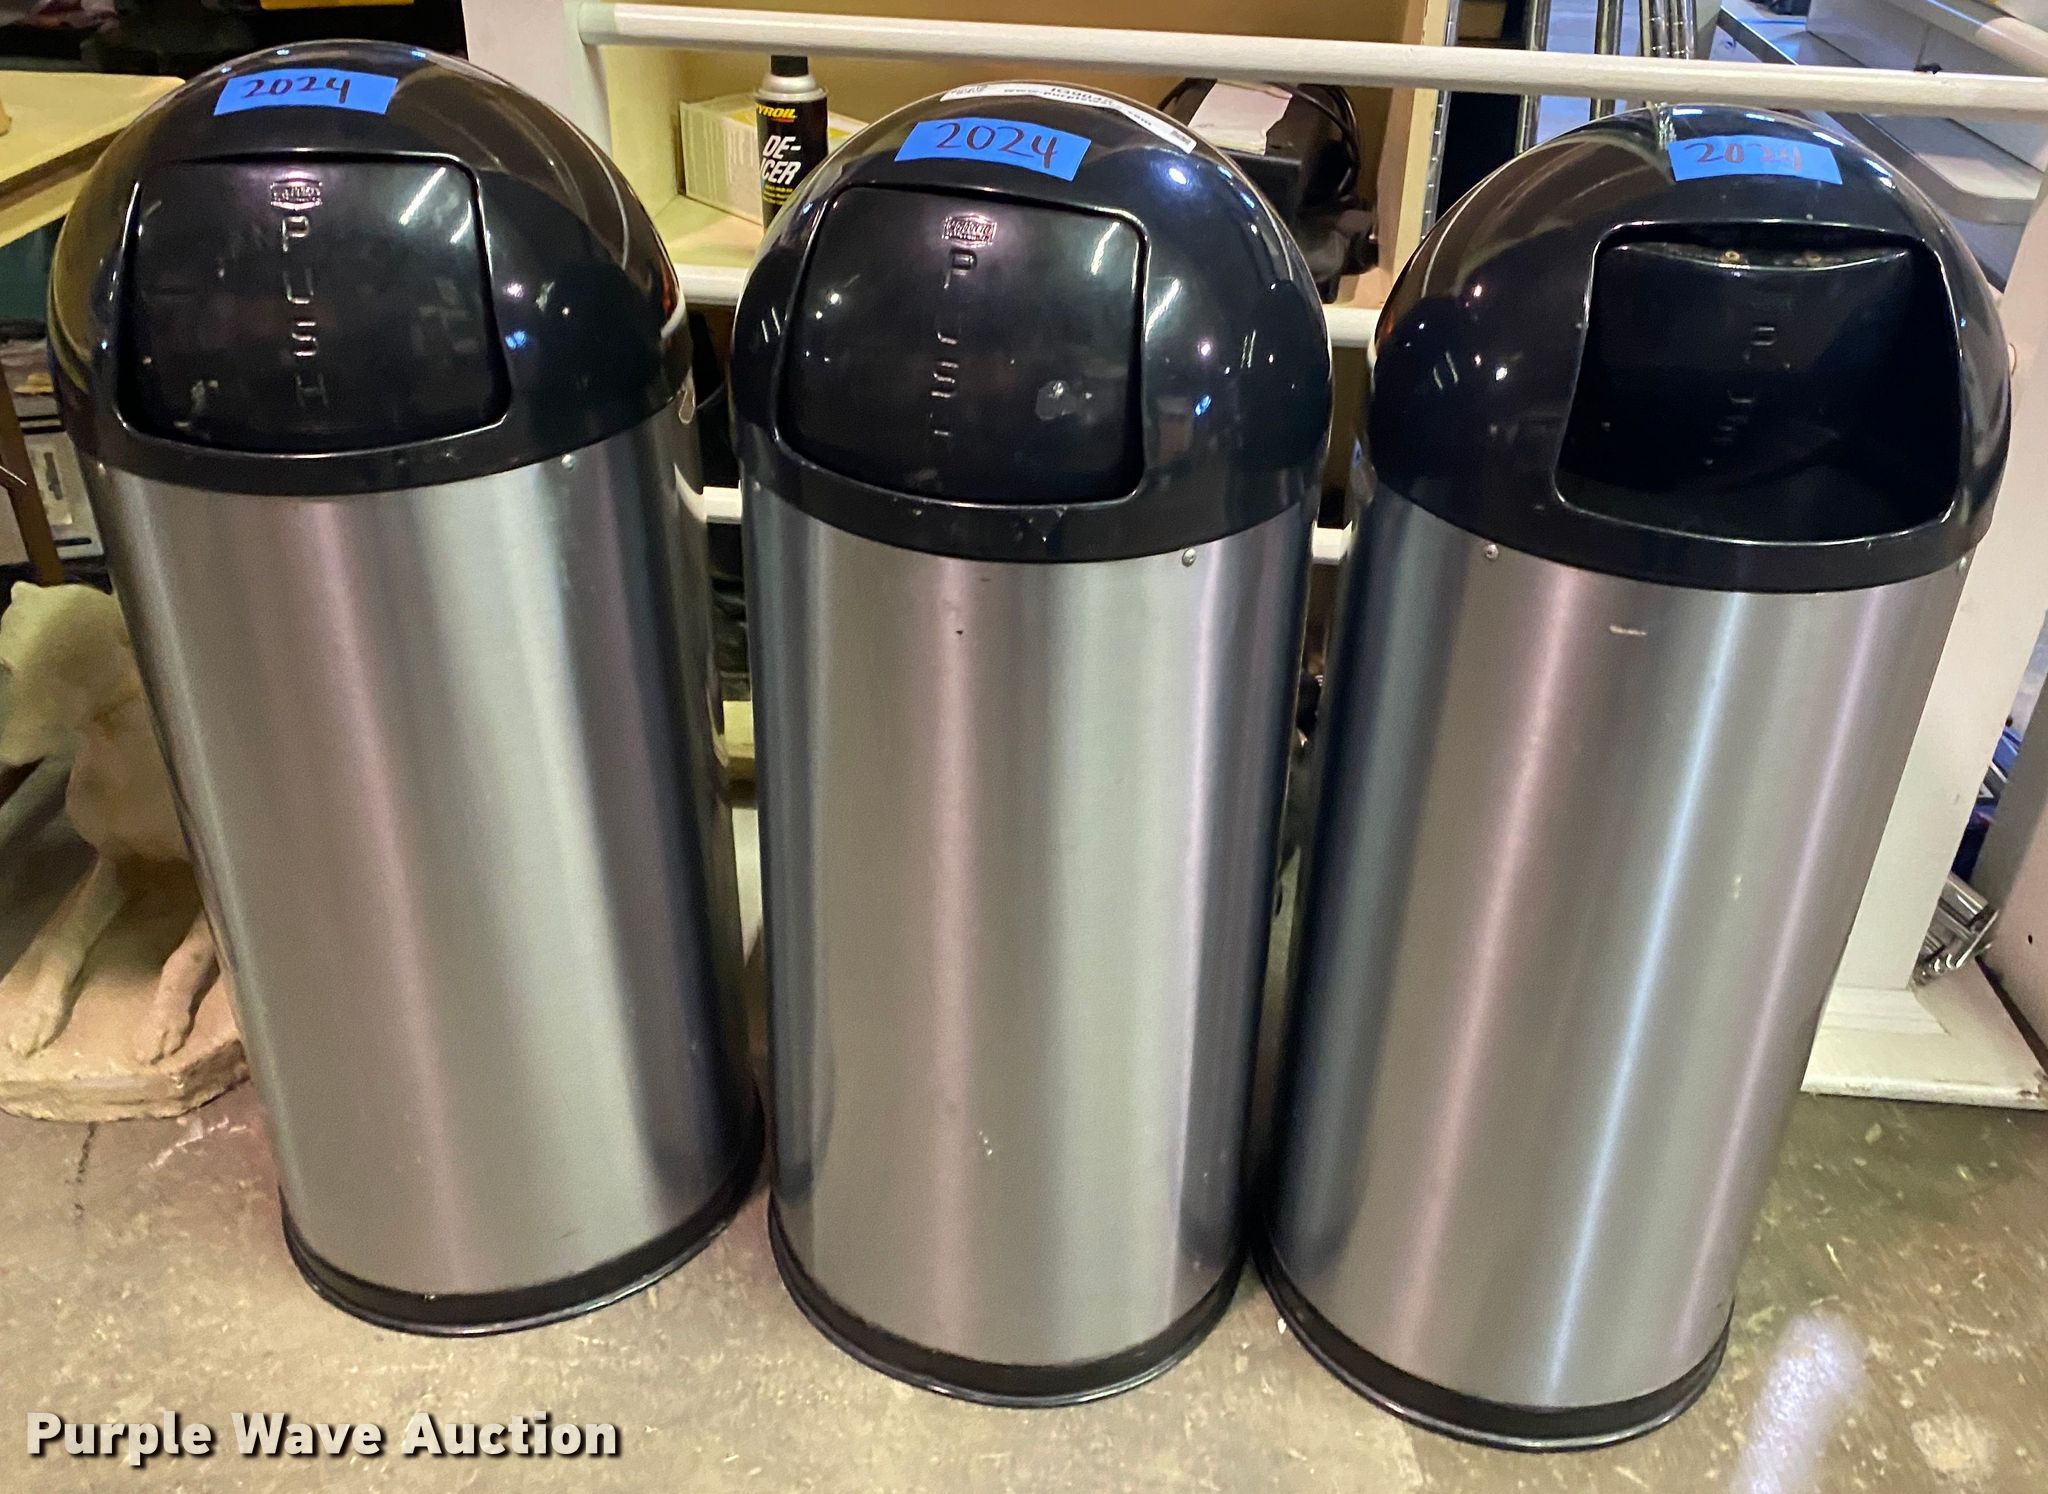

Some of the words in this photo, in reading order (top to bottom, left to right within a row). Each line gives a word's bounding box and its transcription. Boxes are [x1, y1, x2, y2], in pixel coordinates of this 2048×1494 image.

[242, 75, 350, 105] 2024
[762, 134, 802, 159] DE-
[935, 122, 1058, 169] 2024
[1684, 143, 1803, 172] 2024
[281, 215, 330, 409] PUSH
